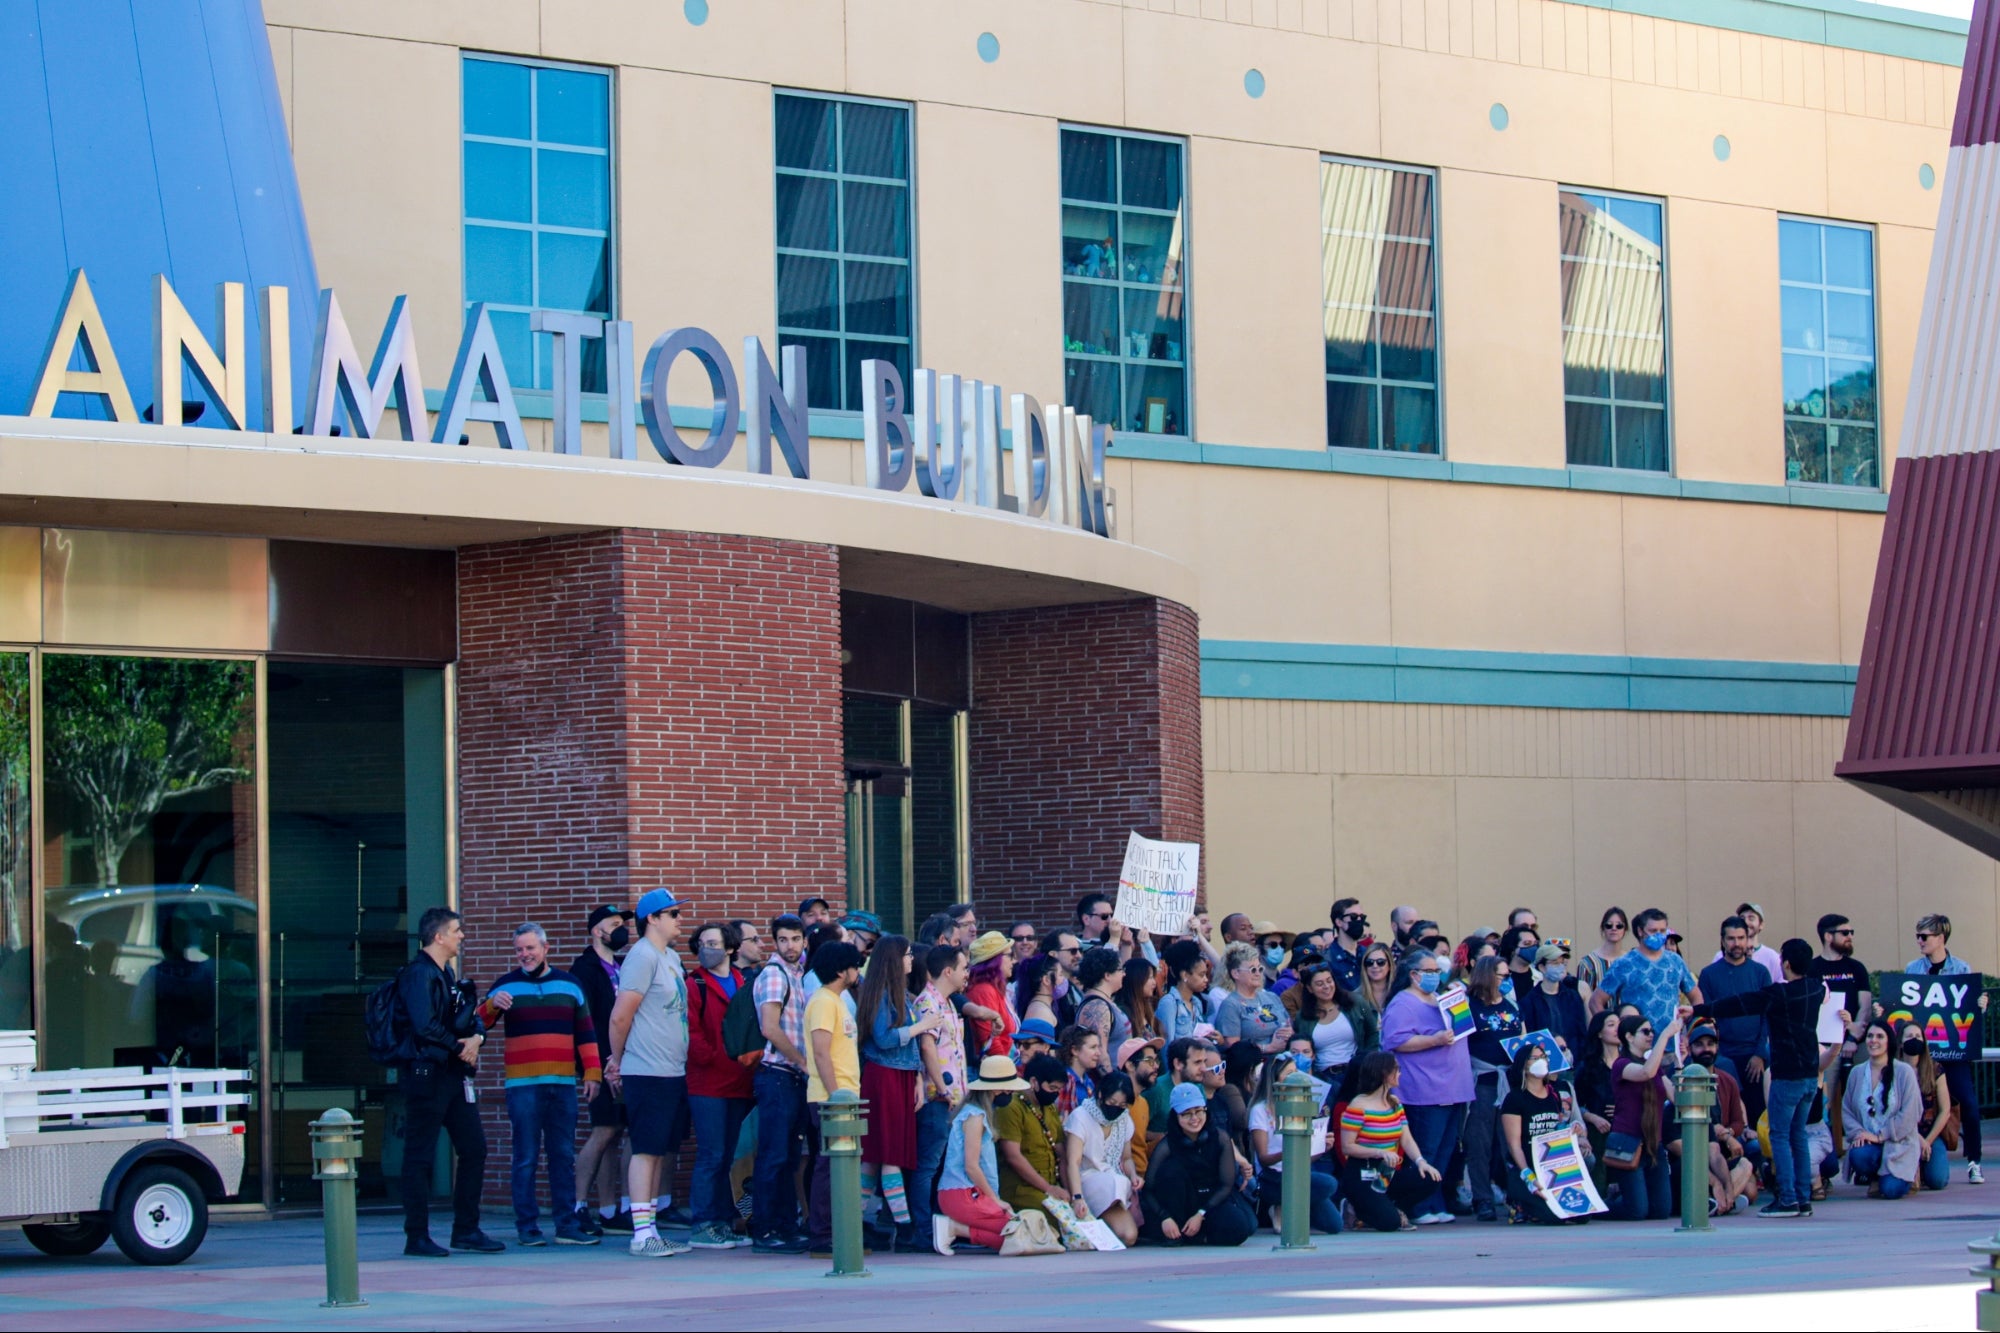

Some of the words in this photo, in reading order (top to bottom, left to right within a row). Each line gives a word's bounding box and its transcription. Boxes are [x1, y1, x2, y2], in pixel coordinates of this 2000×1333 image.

[29, 267, 811, 480] ANIMATION
[861, 359, 1117, 539] BUILDING
[1158, 850, 1187, 871] TALK
[1131, 887, 1144, 907] DO
[1901, 980, 1968, 1009] SAY
